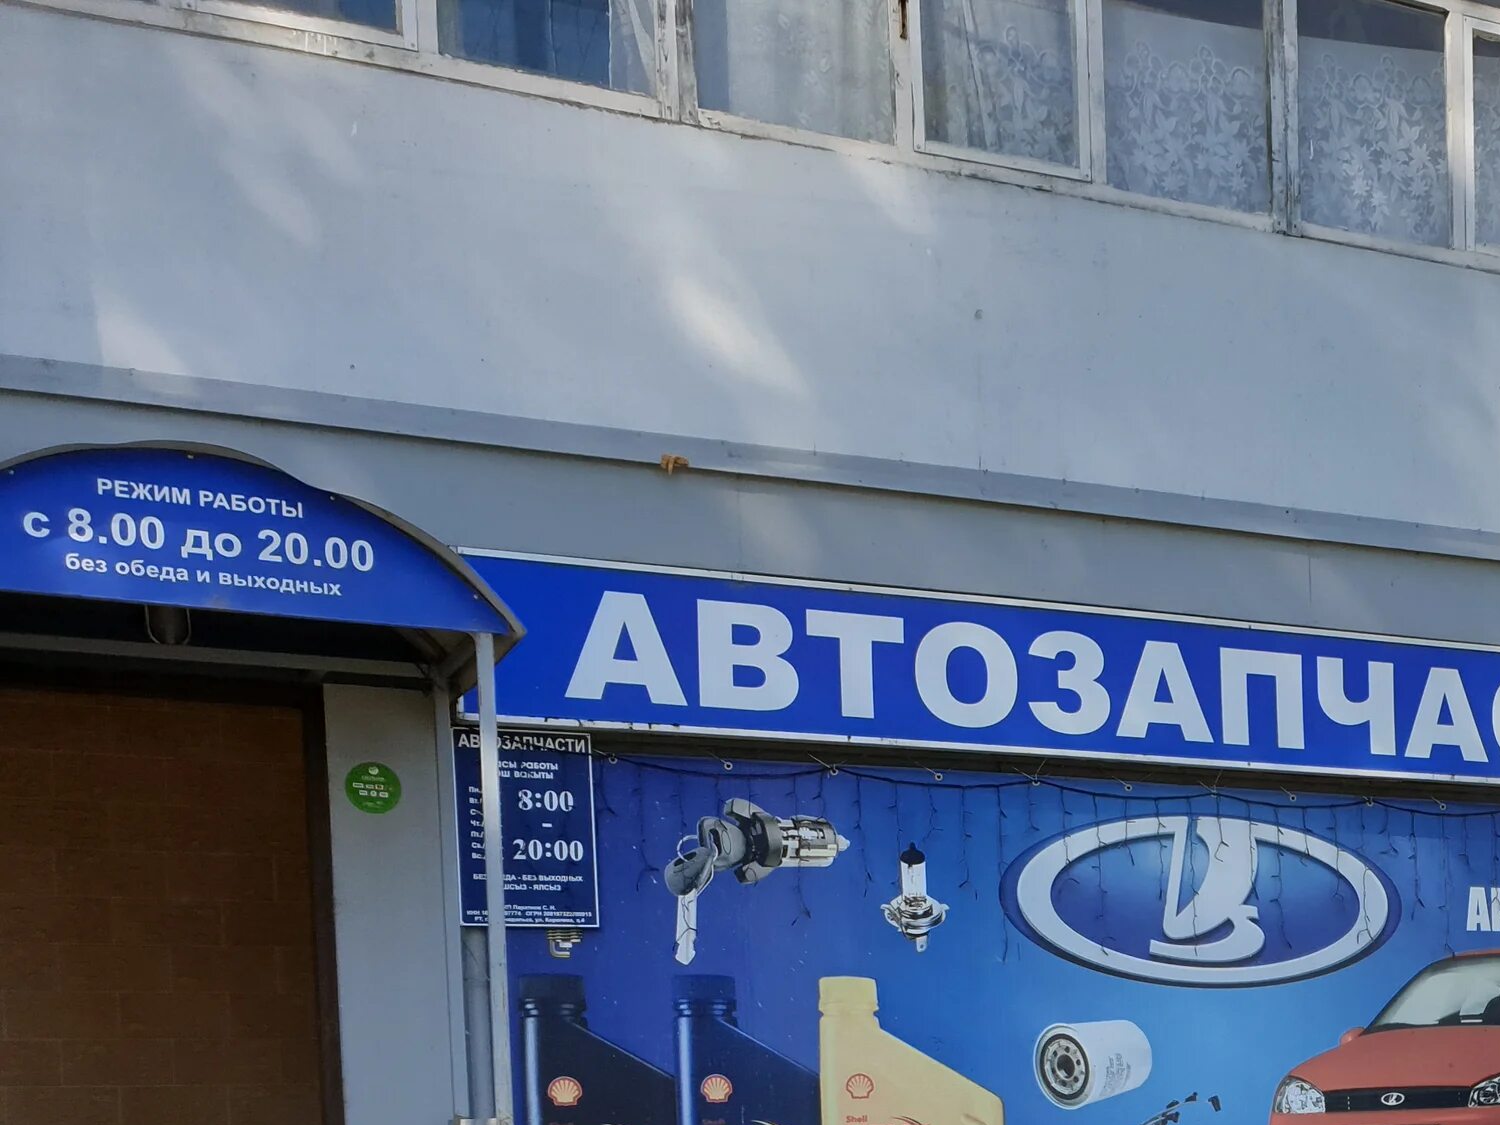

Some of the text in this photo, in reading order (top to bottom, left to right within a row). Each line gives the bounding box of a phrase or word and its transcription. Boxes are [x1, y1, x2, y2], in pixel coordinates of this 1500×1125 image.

[97, 478, 304, 519] РЕЖИМ РАБОТЫ
[23, 508, 375, 572] с 8.00 до 20.00
[66, 553, 342, 597] без обеда и выходных
[458, 733, 586, 754] АВЗАПЧАСТИ
[518, 788, 575, 812] 8:00
[512, 838, 584, 862] 20:00
[845, 1114, 868, 1124] Shell
